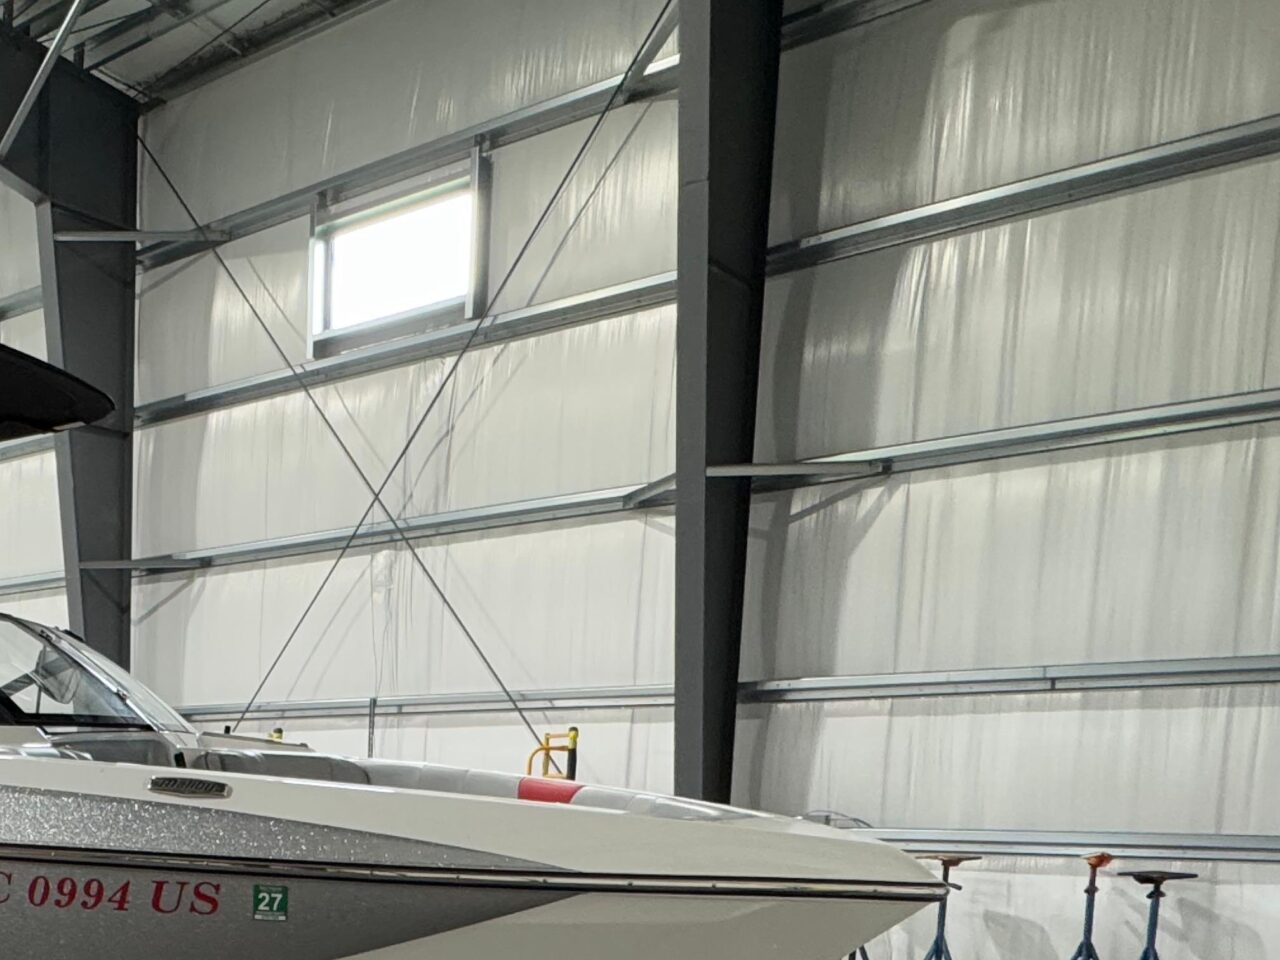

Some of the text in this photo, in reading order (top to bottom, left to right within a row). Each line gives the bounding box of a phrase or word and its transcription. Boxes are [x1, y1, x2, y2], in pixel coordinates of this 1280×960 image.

[28, 875, 131, 911] 0994
[150, 880, 220, 915] US
[258, 892, 283, 911] 27
